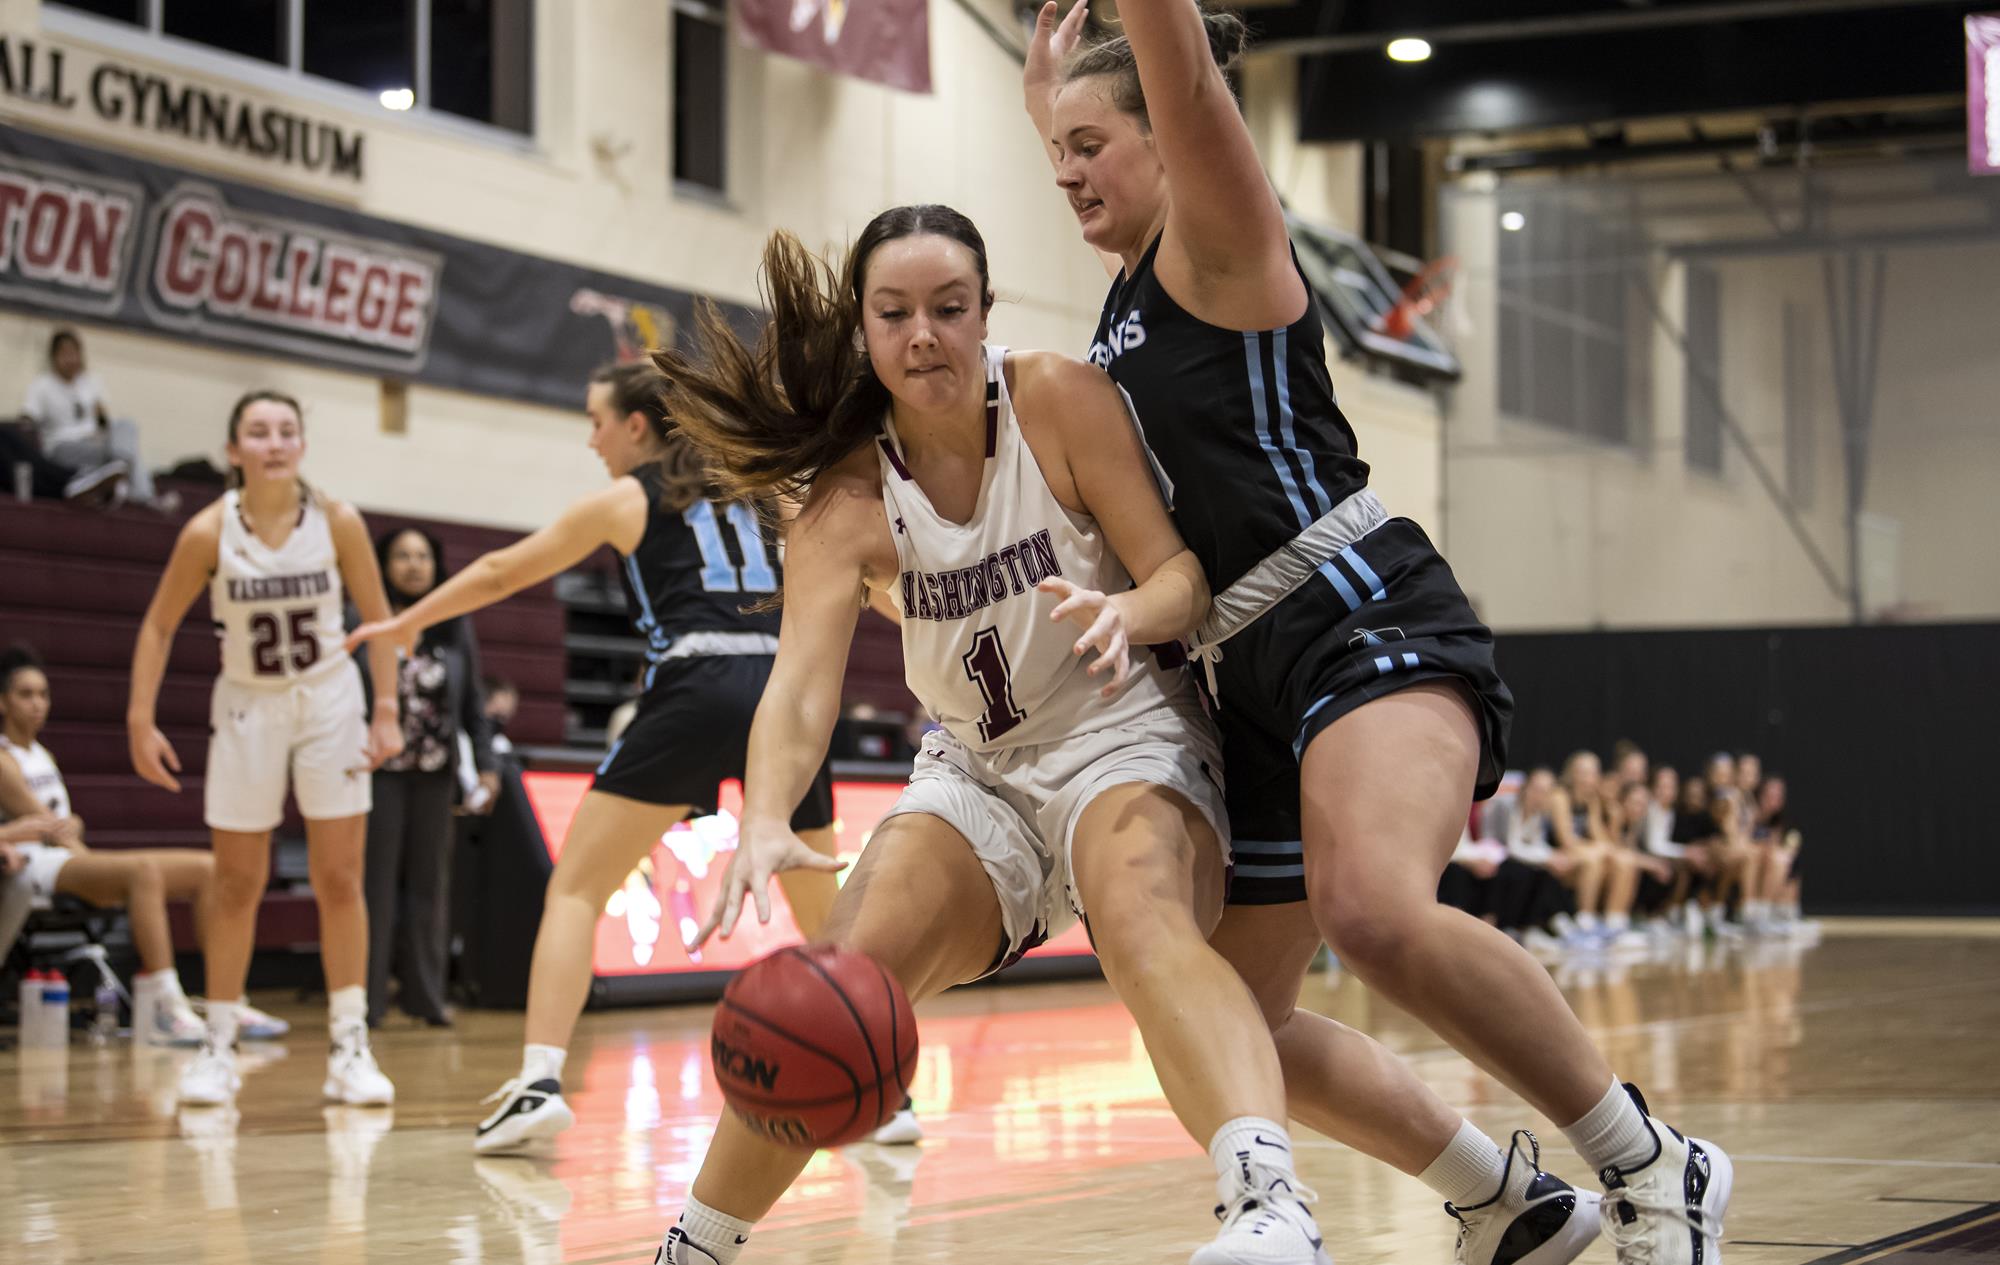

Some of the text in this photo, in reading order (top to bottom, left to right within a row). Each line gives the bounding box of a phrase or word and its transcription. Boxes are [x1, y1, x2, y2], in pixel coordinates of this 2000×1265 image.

[89, 63, 365, 182] GYMNASIUM
[163, 206, 426, 340] COLLEGE
[682, 497, 777, 592] 11
[249, 607, 321, 676] 25
[962, 624, 1027, 743] 1
